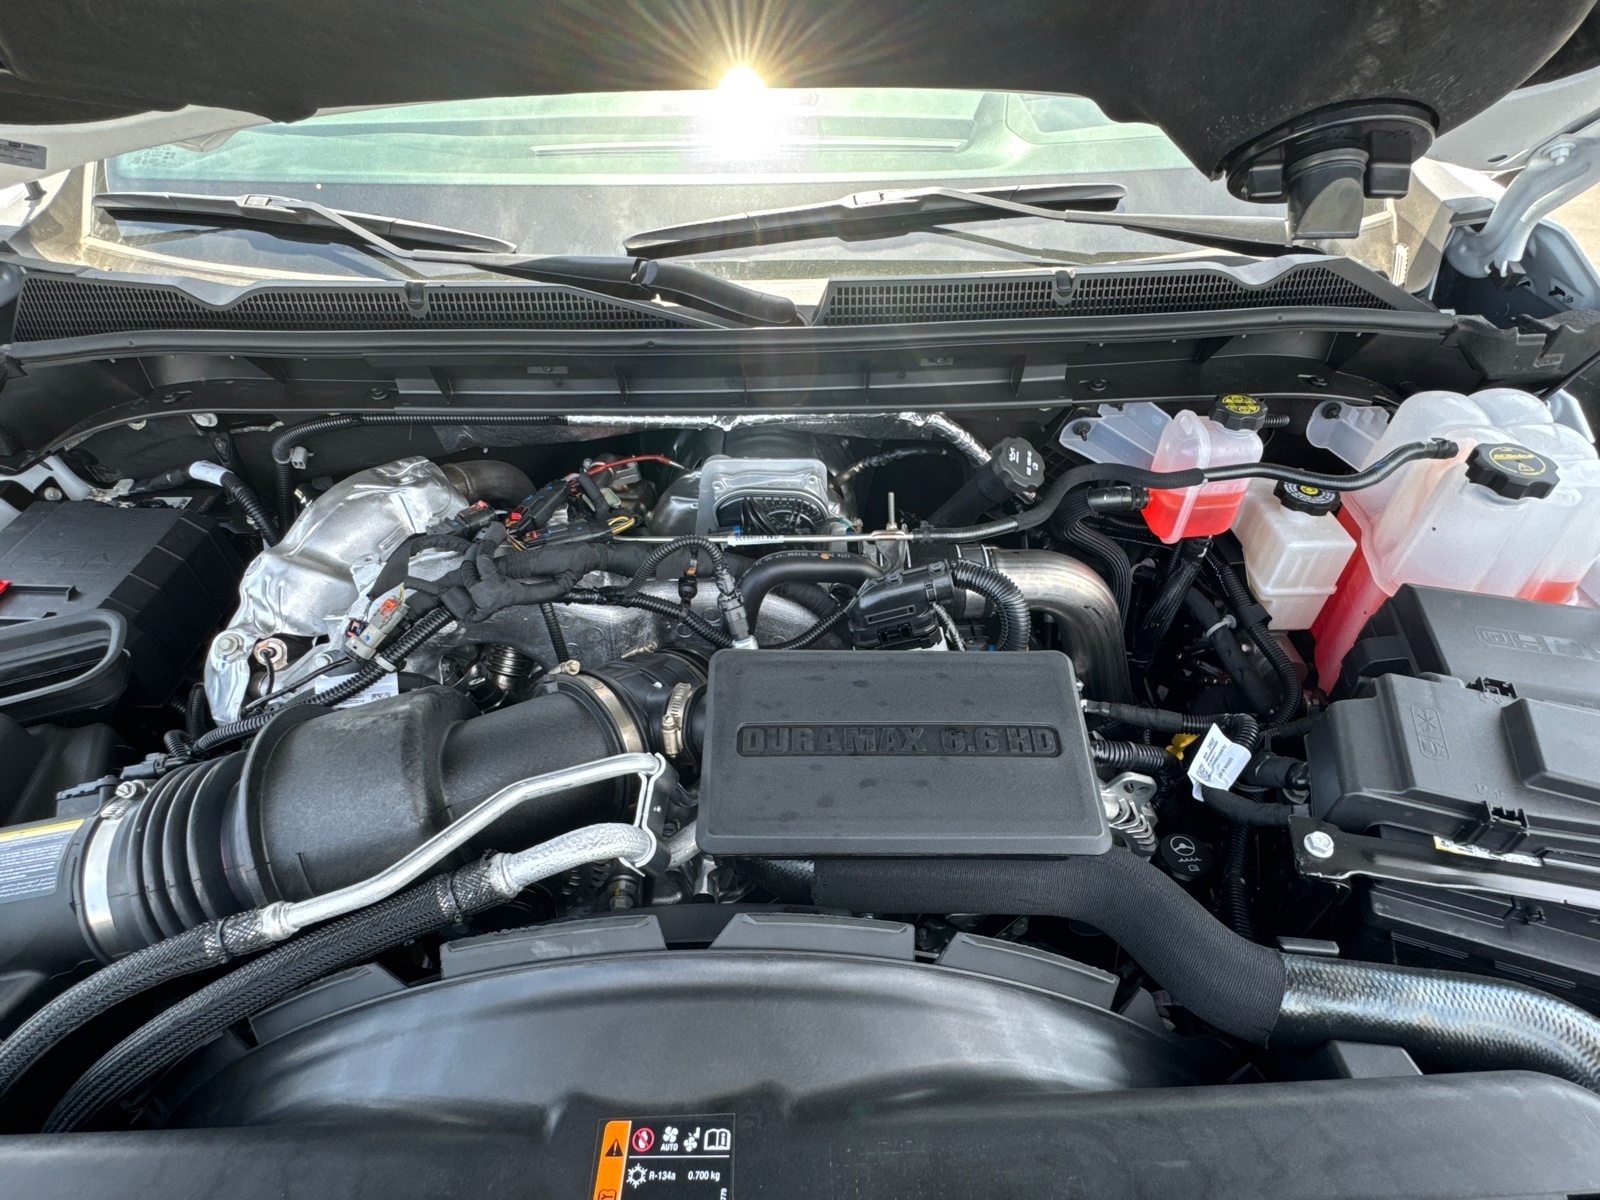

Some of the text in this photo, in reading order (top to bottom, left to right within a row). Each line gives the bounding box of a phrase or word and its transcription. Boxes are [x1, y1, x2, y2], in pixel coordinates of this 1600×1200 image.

[742, 727, 1056, 754] DURAMAX 6.6 HD
[660, 1142, 679, 1151] AUTO
[648, 1170, 721, 1182] R-134a 0.700 kg
